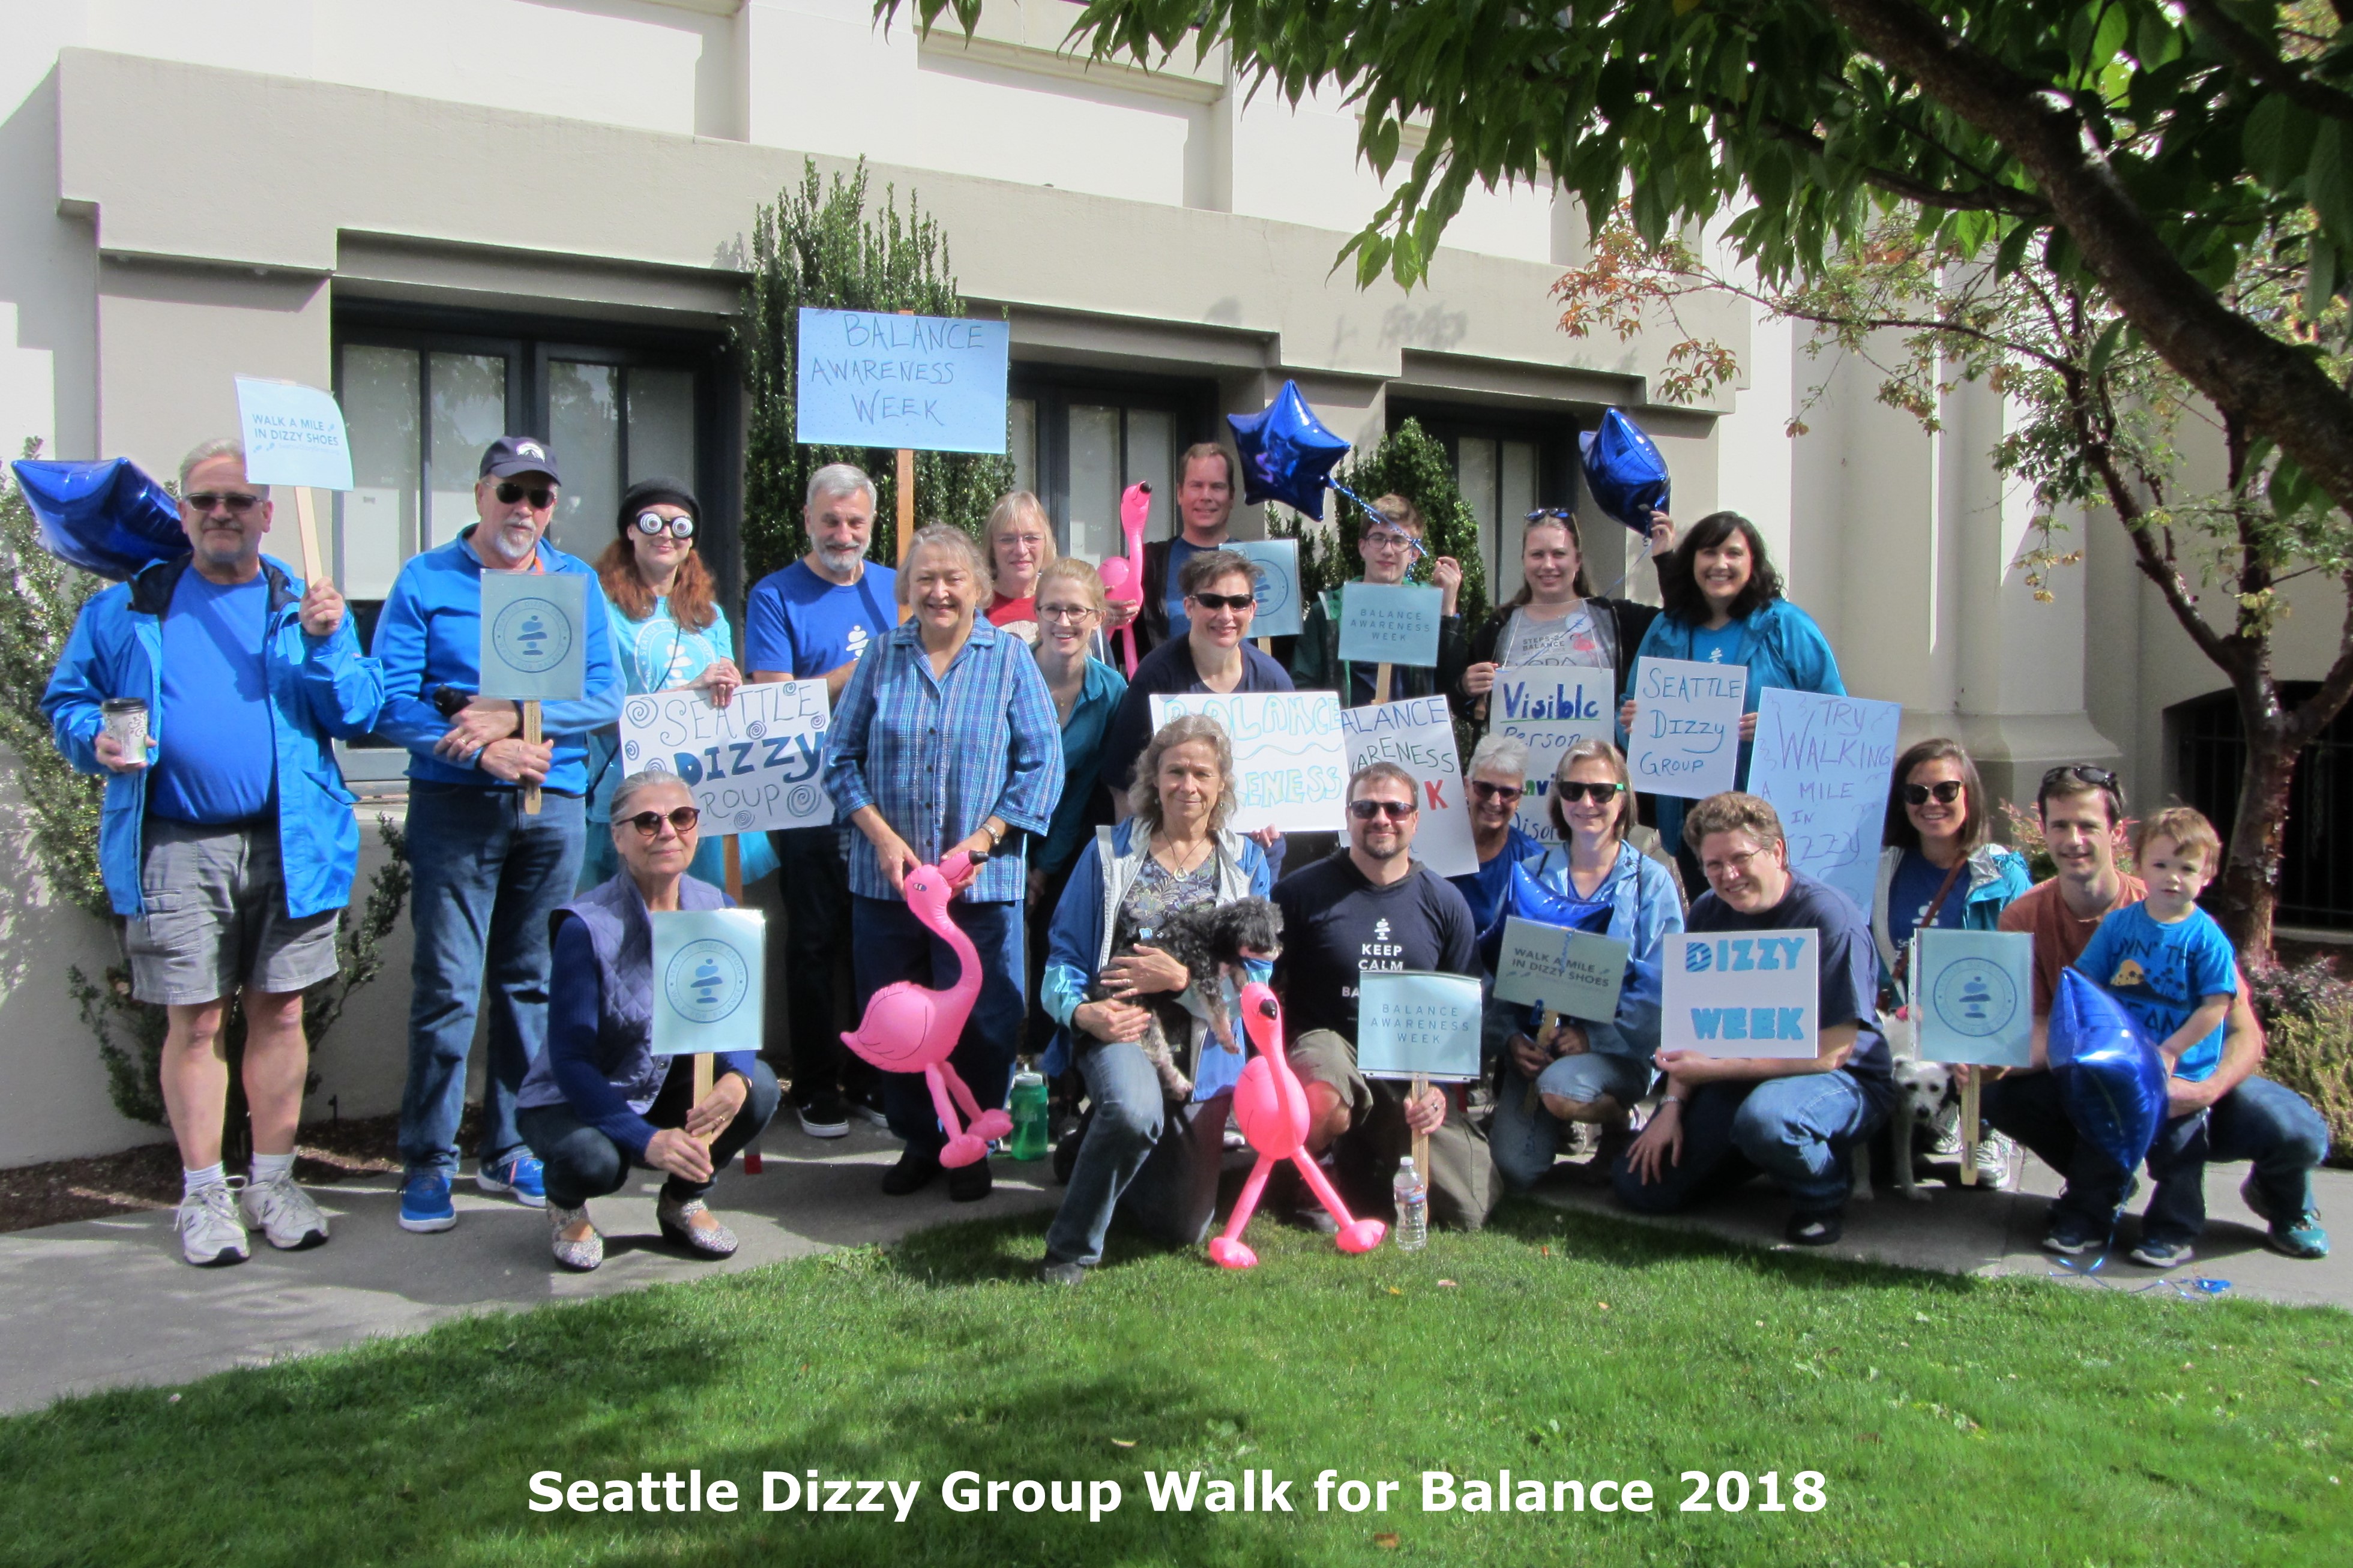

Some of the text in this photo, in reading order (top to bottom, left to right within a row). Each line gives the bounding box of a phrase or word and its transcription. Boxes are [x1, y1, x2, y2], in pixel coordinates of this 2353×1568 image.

[844, 314, 985, 354] BALANCE
[812, 358, 954, 386] AWARENESS
[851, 389, 945, 427] WEEK
[252, 413, 325, 431] WALK A MILE
[255, 428, 339, 446] IN DIZZY SHOES
[1351, 619, 1430, 632] AWARENESS
[1361, 608, 1421, 620] BALANCE
[1372, 632, 1406, 641] WEEK
[1643, 667, 1740, 703] SEATTLE
[660, 685, 819, 746] SEATTLE
[1341, 698, 1448, 734] ALANCE
[1777, 710, 1891, 773] WALKING
[673, 731, 825, 787] DIZZY
[1640, 751, 1704, 776] GROUP
[699, 784, 780, 819] ROUP
[1761, 781, 1854, 803] A MILE
[1791, 810, 1816, 825] IN
[1362, 943, 1402, 957] KEEP
[1514, 947, 1550, 962] WALK
[1566, 960, 1595, 973] MILE
[1686, 937, 1806, 972] DIZZY
[1358, 959, 1404, 970] CALM
[1512, 958, 1526, 969] IN
[1530, 962, 1564, 978] DIZZY
[1568, 971, 1609, 987] SHOES
[1382, 1003, 1459, 1017] BALANCE
[1370, 1017, 1469, 1032] AWARENESS
[1690, 1007, 1804, 1041] WEEK
[1397, 1033, 1441, 1044] WEEK
